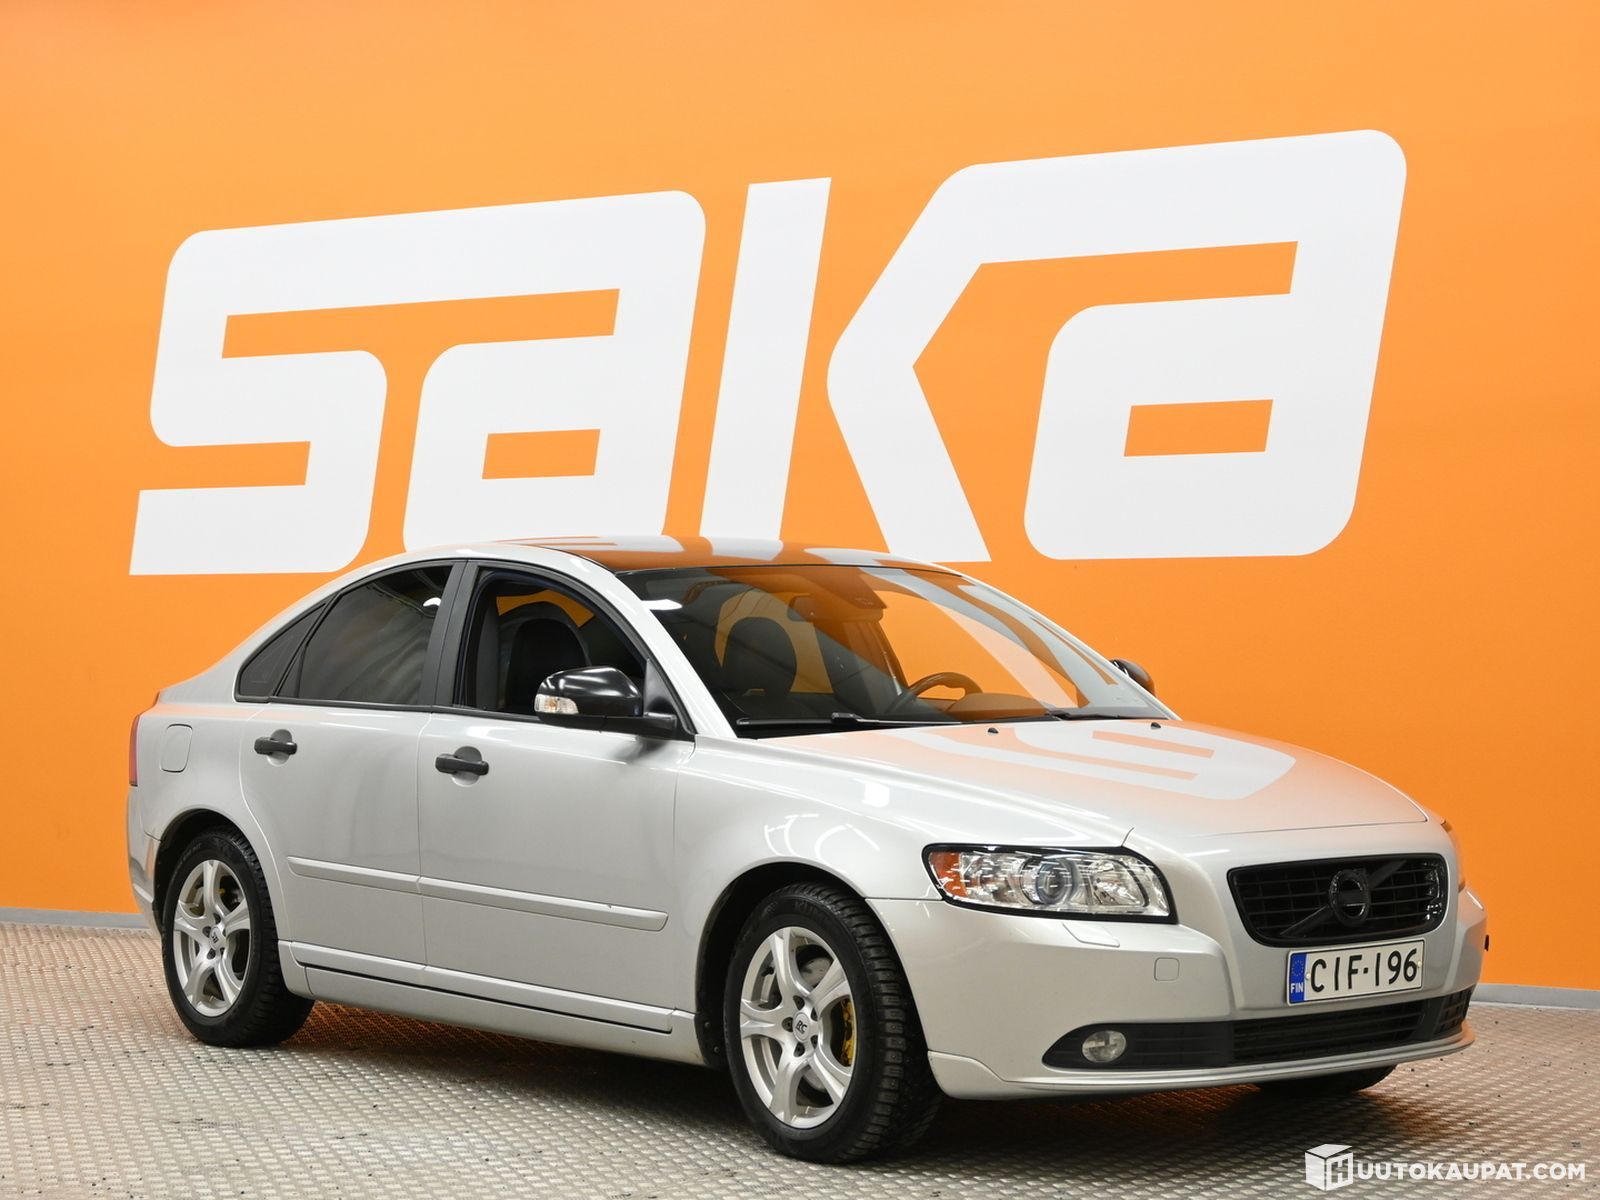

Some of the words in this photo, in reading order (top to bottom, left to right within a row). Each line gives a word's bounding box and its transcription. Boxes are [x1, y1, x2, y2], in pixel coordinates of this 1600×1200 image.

[1310, 948, 1418, 993] CIF-196
[1290, 982, 1304, 994] FIN
[795, 1019, 808, 1034] RC
